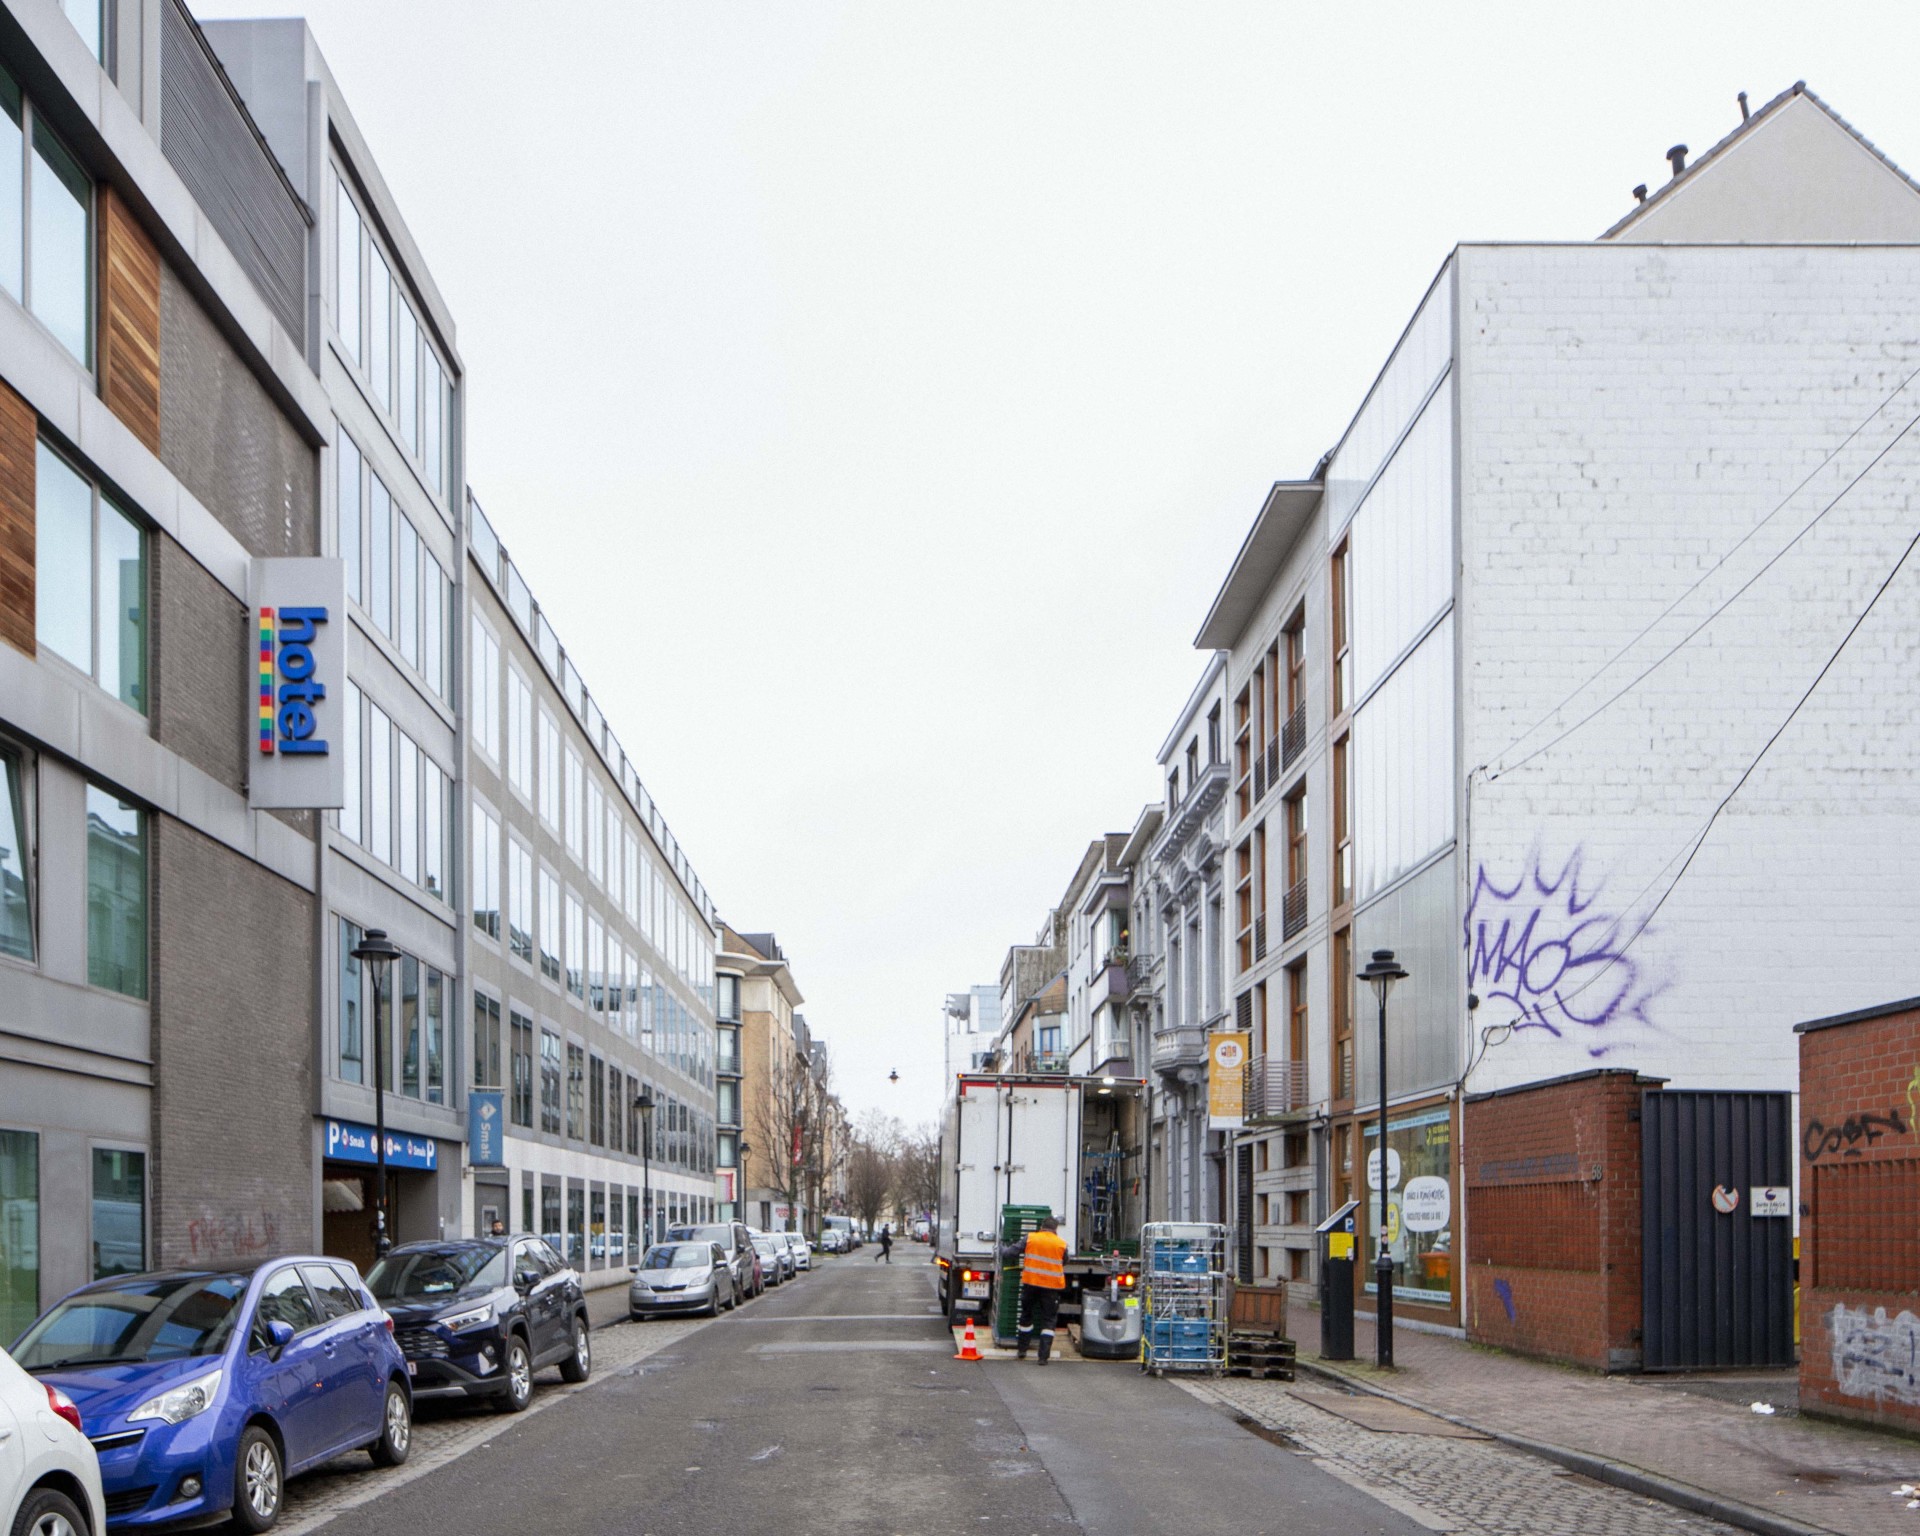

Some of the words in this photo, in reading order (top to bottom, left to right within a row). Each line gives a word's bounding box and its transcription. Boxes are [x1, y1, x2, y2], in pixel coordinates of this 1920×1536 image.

[277, 607, 329, 756] hotel
[329, 1120, 340, 1155] P
[426, 1139, 435, 1167] P
[480, 1122, 492, 1160] Smals
[1345, 1218, 1354, 1232] P
